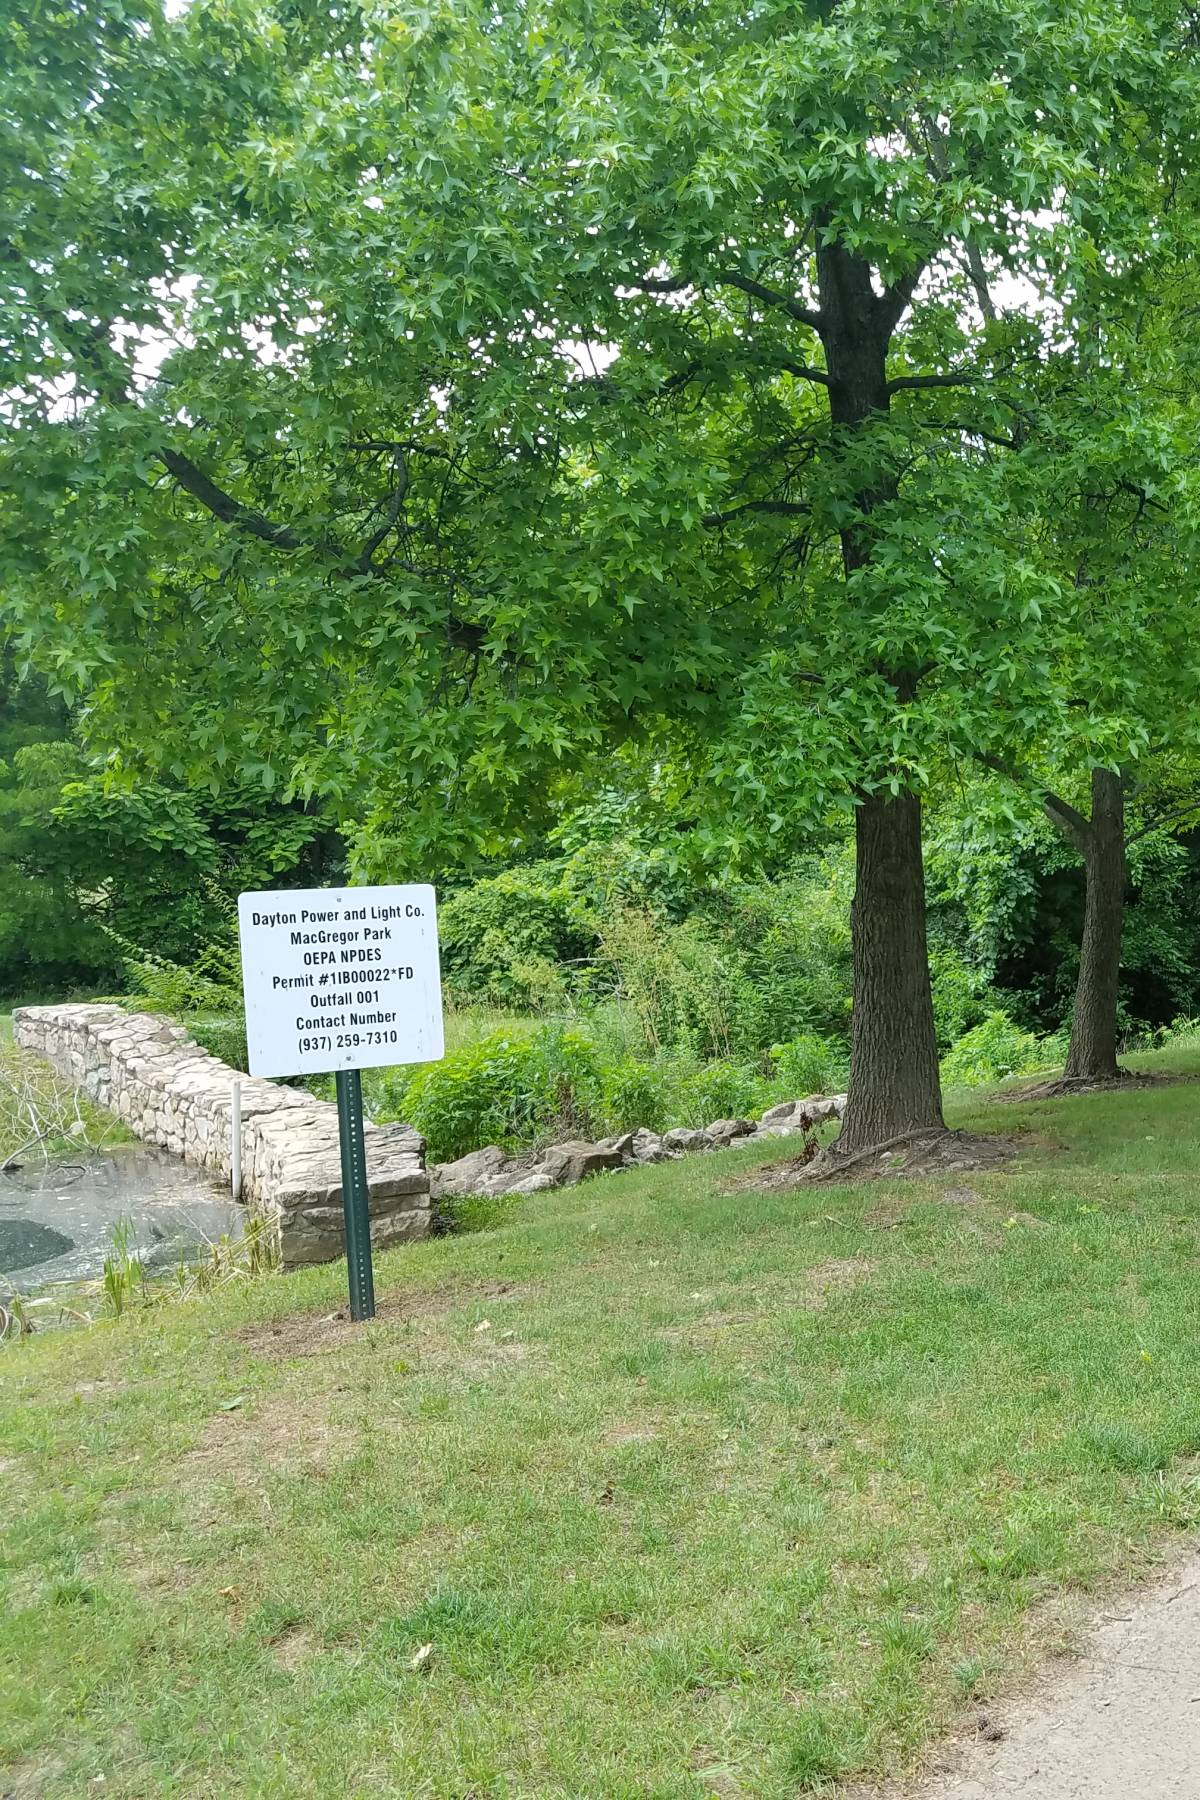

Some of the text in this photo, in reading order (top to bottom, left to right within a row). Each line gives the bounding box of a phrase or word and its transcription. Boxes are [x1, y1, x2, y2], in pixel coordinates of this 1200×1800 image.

[253, 905, 424, 927] Dayton Power and Light Co.
[291, 927, 391, 944] MacGregor Park
[304, 948, 381, 965] OEPA NPDES
[273, 974, 313, 989] Permit
[311, 990, 379, 1007] Outfall 001
[297, 1011, 396, 1030] Contact Number
[299, 1031, 397, 1054] (937) 259-7310
